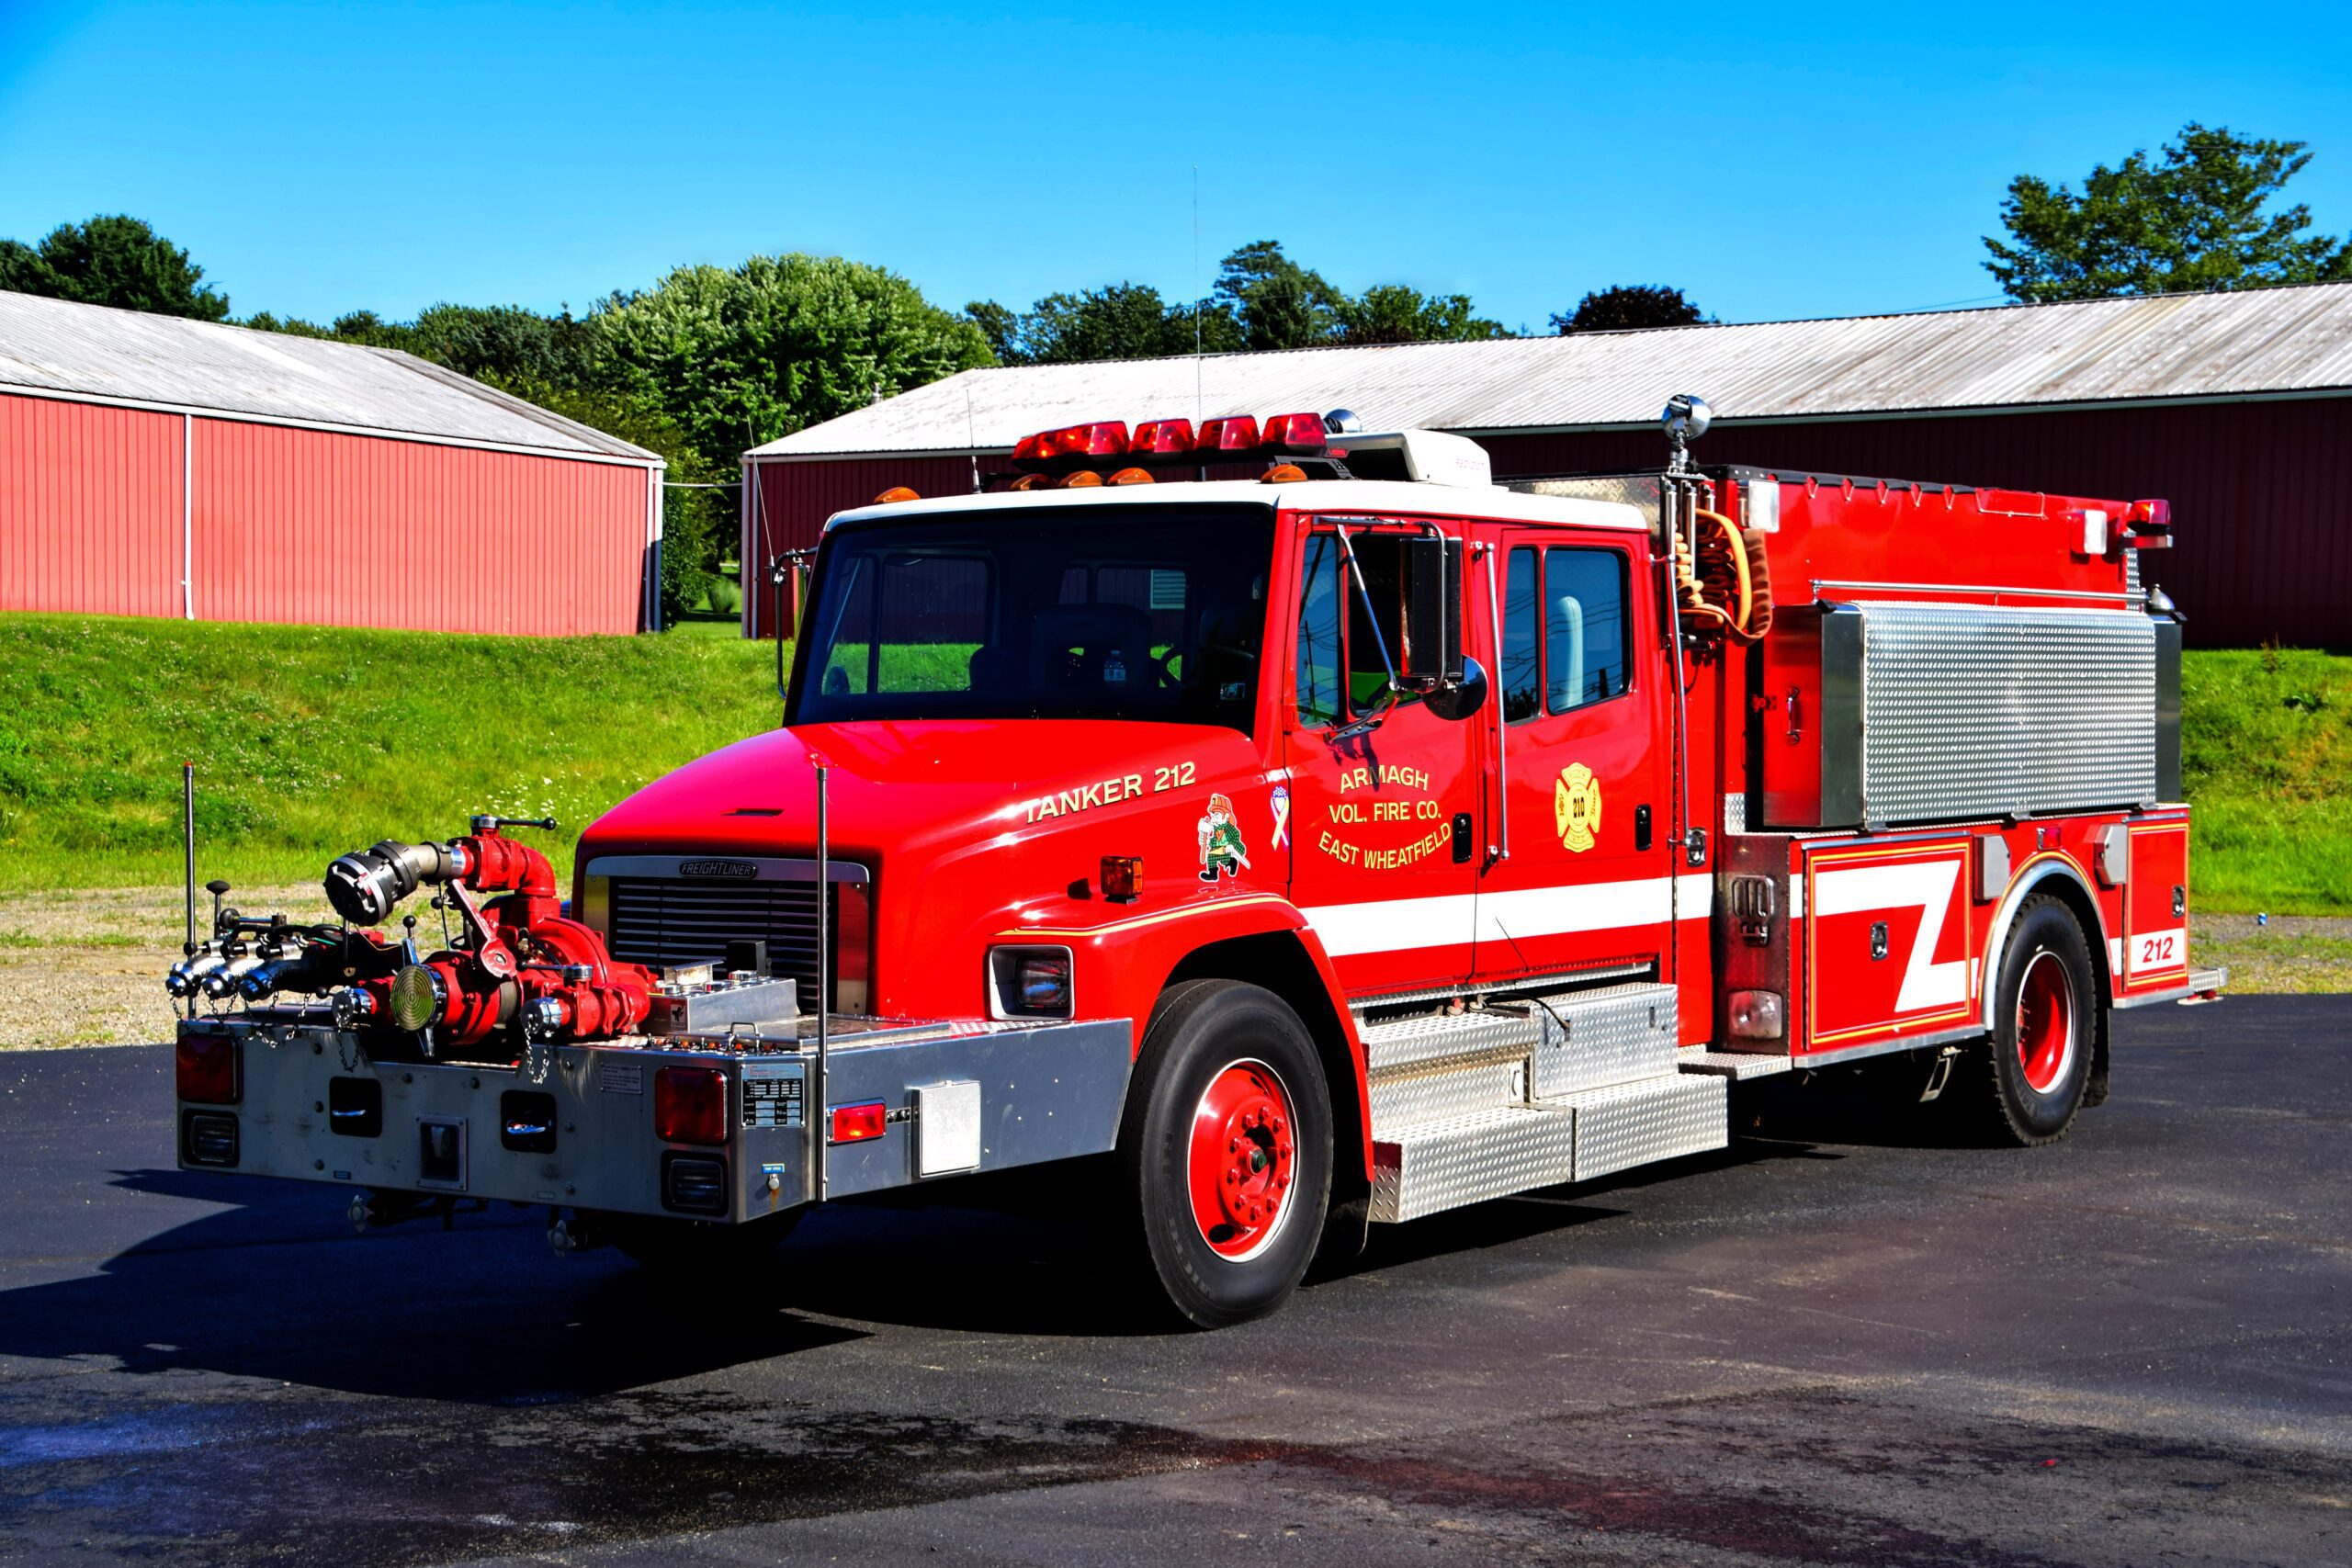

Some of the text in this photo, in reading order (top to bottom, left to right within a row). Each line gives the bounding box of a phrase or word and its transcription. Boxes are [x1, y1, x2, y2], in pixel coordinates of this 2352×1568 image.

[1023, 761, 1196, 824] TANKER 212
[1340, 764, 1430, 794] ARMAGH
[1329, 800, 1442, 824] VOL. FIRE CO.
[1318, 822, 1451, 870] EAST WHEATFIELD
[681, 862, 752, 876] FREIGHTLINER
[2142, 936, 2174, 964] 212
